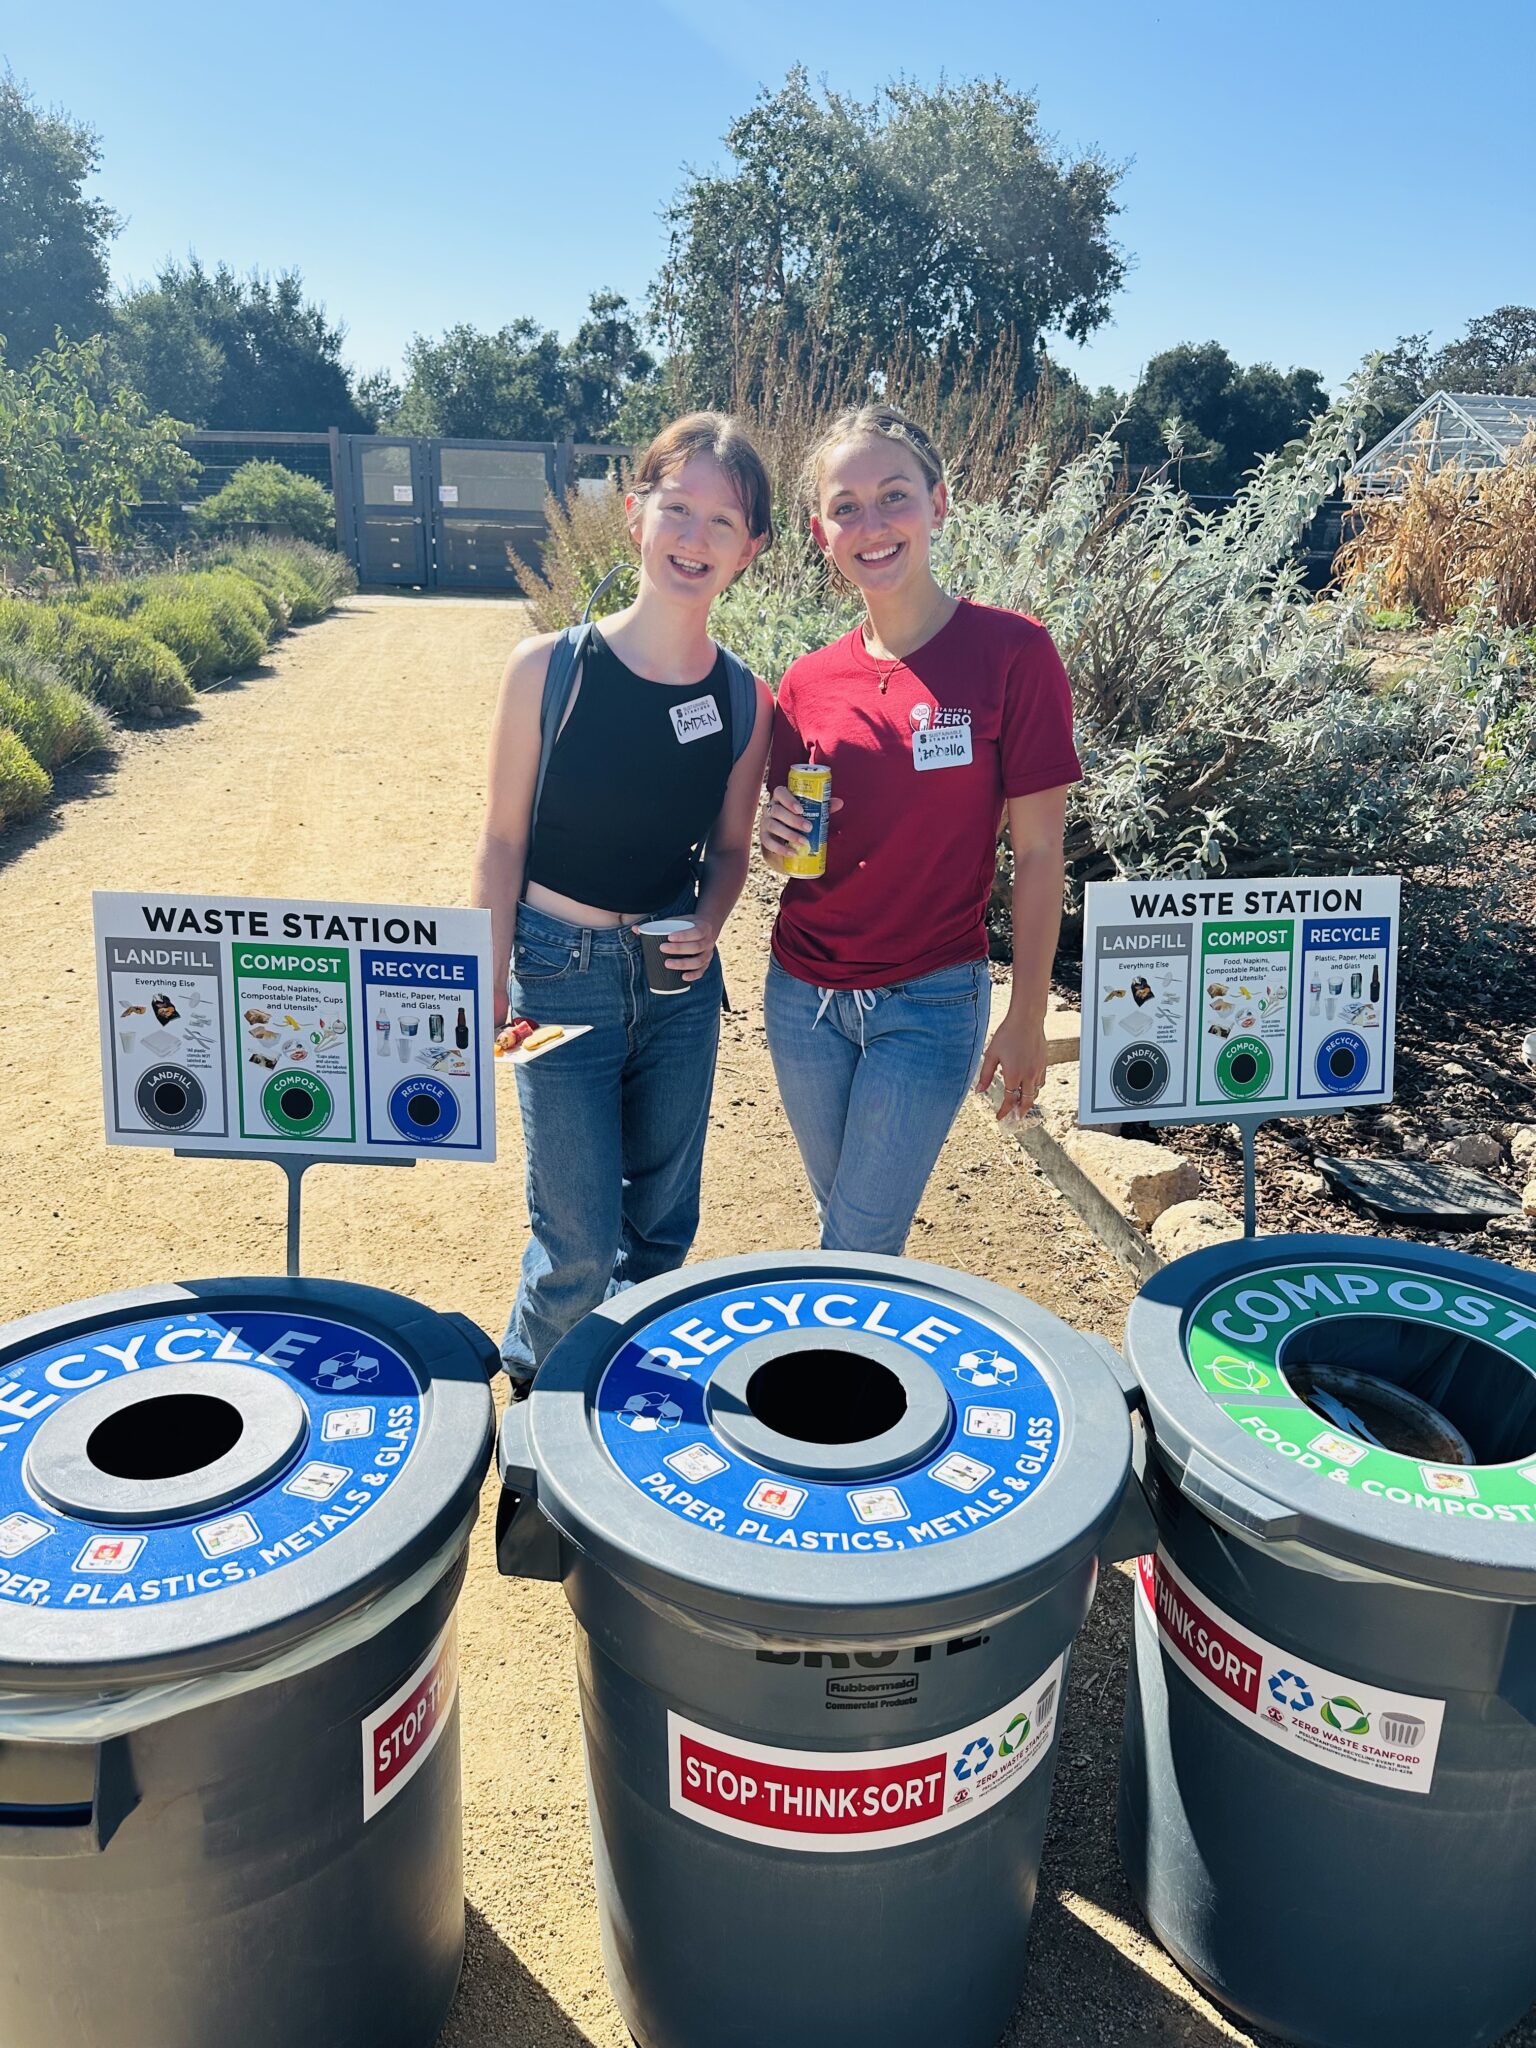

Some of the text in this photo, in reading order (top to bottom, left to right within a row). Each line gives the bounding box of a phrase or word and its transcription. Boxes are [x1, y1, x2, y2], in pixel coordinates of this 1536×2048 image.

[933, 712, 972, 726] ZERO
[1130, 889, 1362, 918] WASTE STATION
[142, 906, 437, 946] WASTE STATION
[1310, 927, 1381, 943] RECYCLE
[1102, 933, 1186, 951] LANDFILL
[1207, 929, 1288, 947] COMPOST
[113, 948, 214, 968] LANDFILL
[239, 953, 342, 974] COMPOST
[1118, 962, 1154, 970] Everything
[371, 960, 465, 981] RECYCLE
[1205, 967, 1248, 975] Compostable
[135, 978, 196, 988] Everything Else
[262, 983, 322, 994] Food, Napkins,
[240, 991, 344, 1005] Compostable Plates, Cups
[379, 990, 461, 1002] Plastic, Paper, Metal
[266, 1002, 282, 1010] and
[401, 1001, 441, 1010] and Glass
[1226, 1042, 1263, 1058] COMPOST
[1325, 1036, 1360, 1053] RECYCLE
[1121, 1049, 1160, 1066] LANDFILL
[147, 1071, 193, 1090] LANDFILL
[273, 1075, 321, 1093] COMPOST
[401, 1082, 445, 1098] RECYCLE
[1211, 1273, 1536, 1343] COMPOST
[636, 1292, 962, 1382] RECYCLE
[374, 1404, 414, 1467] GLASS
[1239, 1416, 1536, 1522] FOOD & COMPOST
[363, 1472, 389, 1487] &
[640, 1416, 1054, 1552] PAPER, PLASTICS, METALS & GLASS
[259, 1486, 372, 1565] METALS
[63, 1560, 256, 1605] PLASTICS,
[830, 1677, 916, 1693] Rubbermaid
[825, 1696, 918, 1710] Commercial Products
[1322, 1730, 1360, 1750] WASTE
[1361, 1745, 1421, 1764] STANFORD
[1000, 1750, 1024, 1773] WASTE
